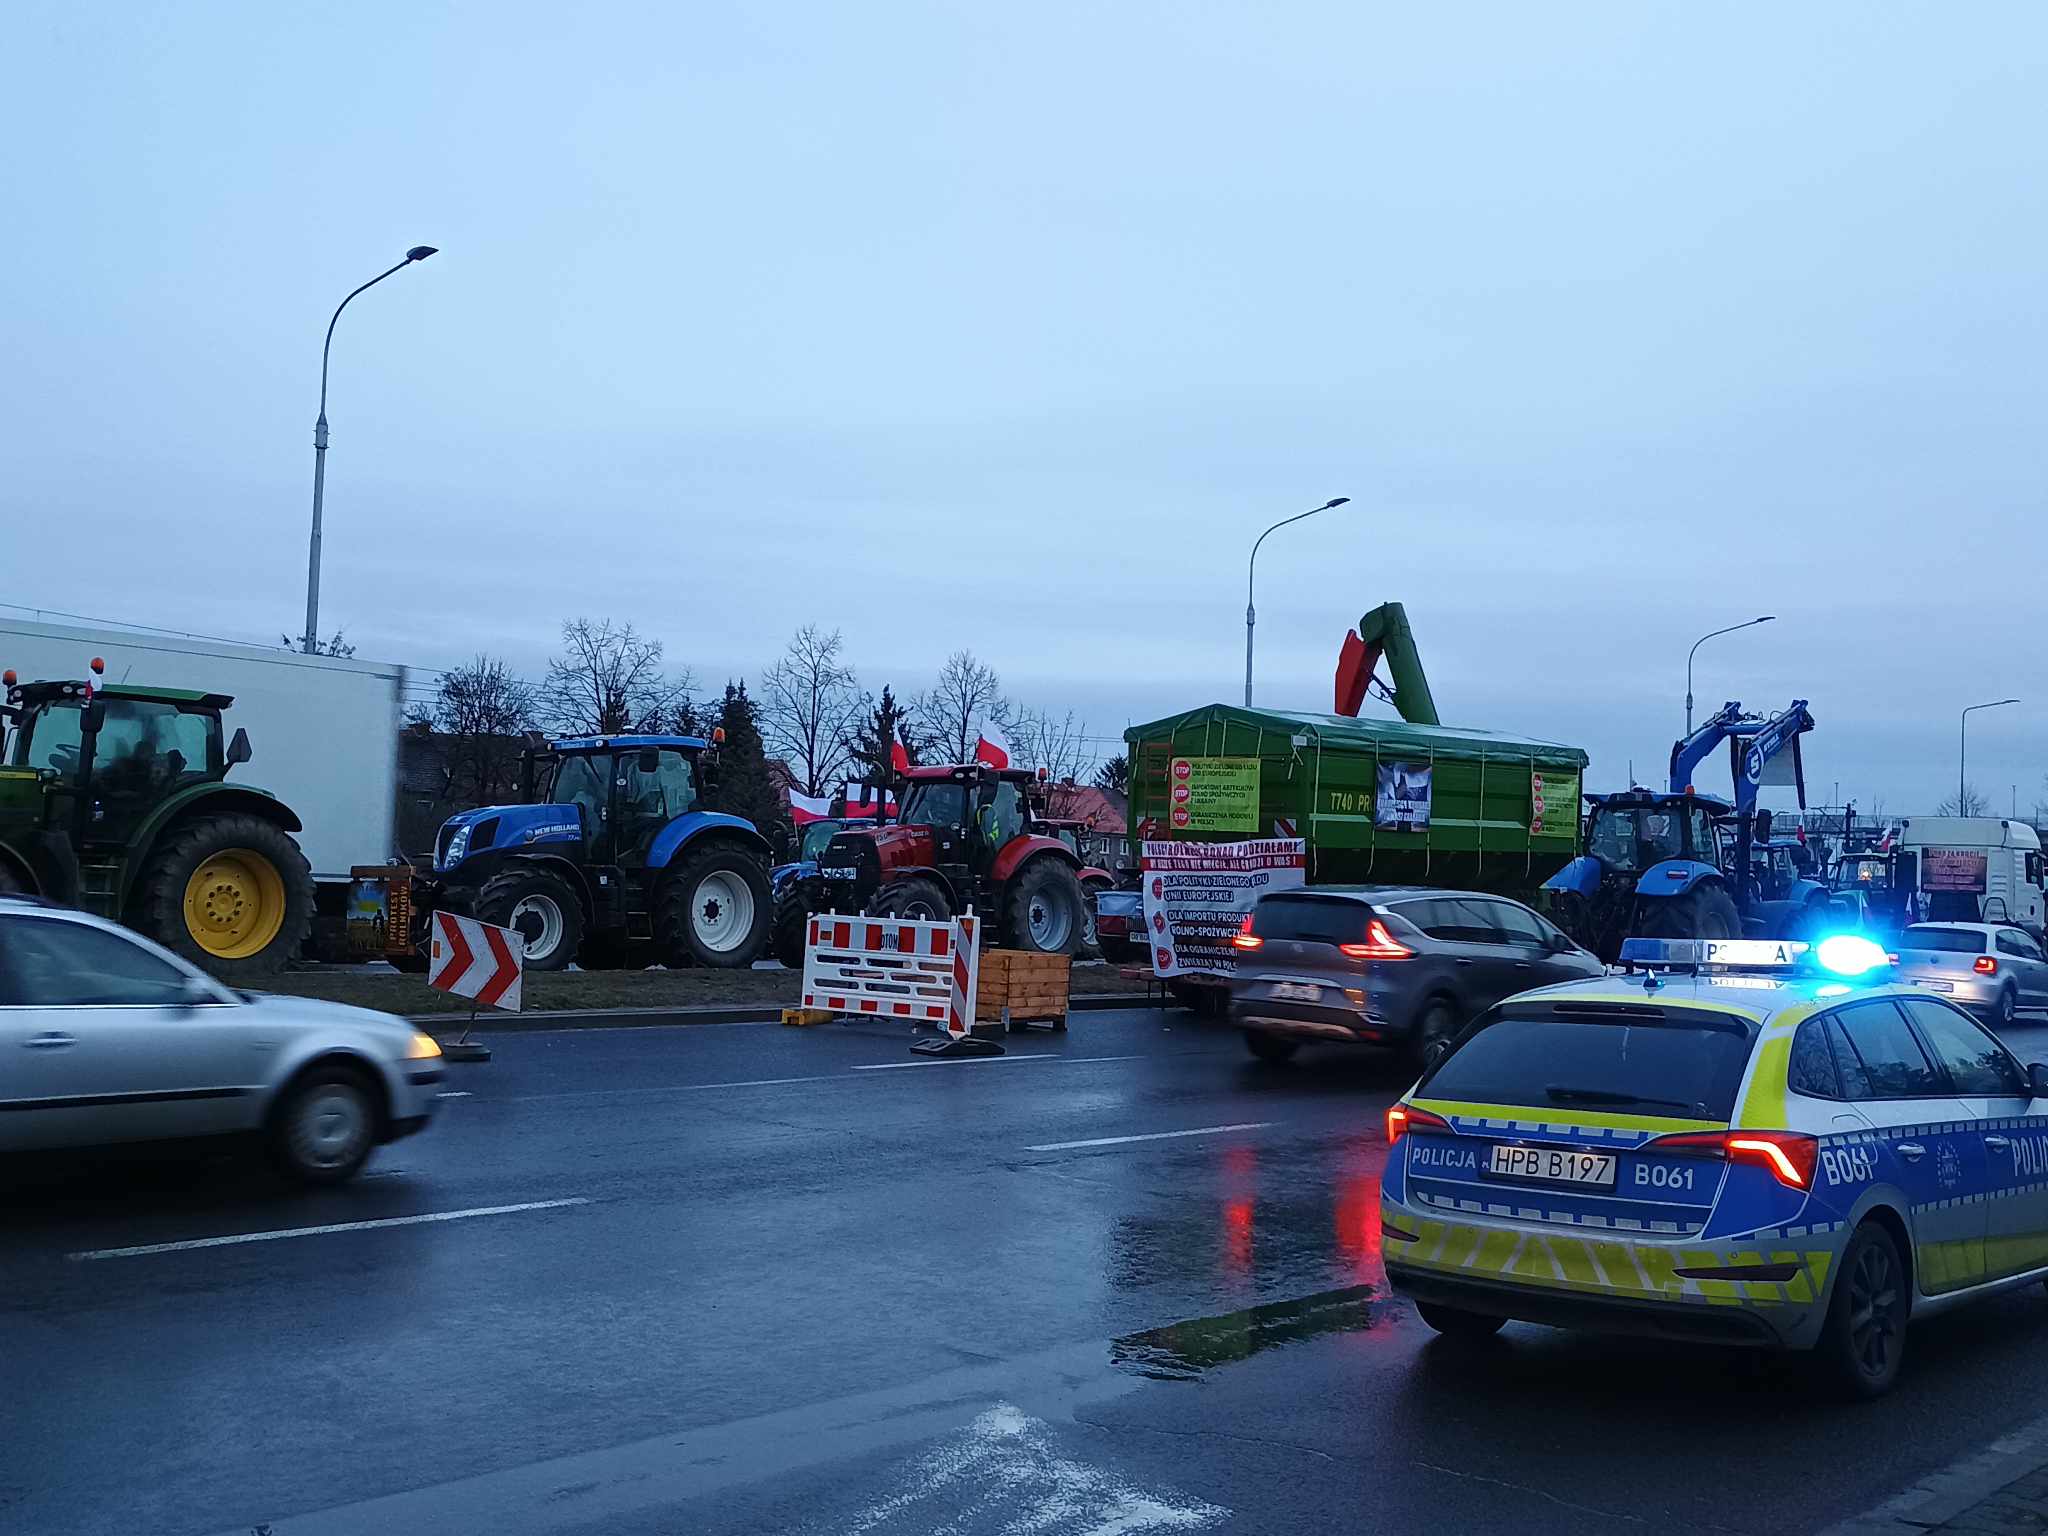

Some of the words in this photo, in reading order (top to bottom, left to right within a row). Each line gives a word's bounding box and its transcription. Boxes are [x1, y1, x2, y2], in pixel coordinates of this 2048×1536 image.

[1175, 766, 1190, 774] STOP
[1175, 789, 1189, 797] STOP
[1331, 792, 1353, 811] T740
[1358, 794, 1374, 812] PR
[1174, 812, 1188, 820] STOP
[534, 827, 550, 836] NEW
[551, 824, 580, 832] HOLLAND
[1274, 855, 1291, 866] WAS
[1163, 876, 1178, 887] DLA
[1178, 876, 1211, 887] POLITYKI
[1212, 876, 1250, 888] ZIELONEGO
[1164, 891, 1182, 902] UNII
[1183, 891, 1233, 902] EUROPEJSKIEJ
[389, 891, 399, 941] PROTEST
[1168, 911, 1183, 921] DLA
[1184, 911, 1216, 922] IMPORTU
[1412, 1147, 1476, 1169] POLICJA
[1495, 1148, 1539, 1175] HPB
[1549, 1153, 1610, 1182] B197
[1821, 1146, 1873, 1186] B061
[1635, 1163, 1694, 1190] B061
